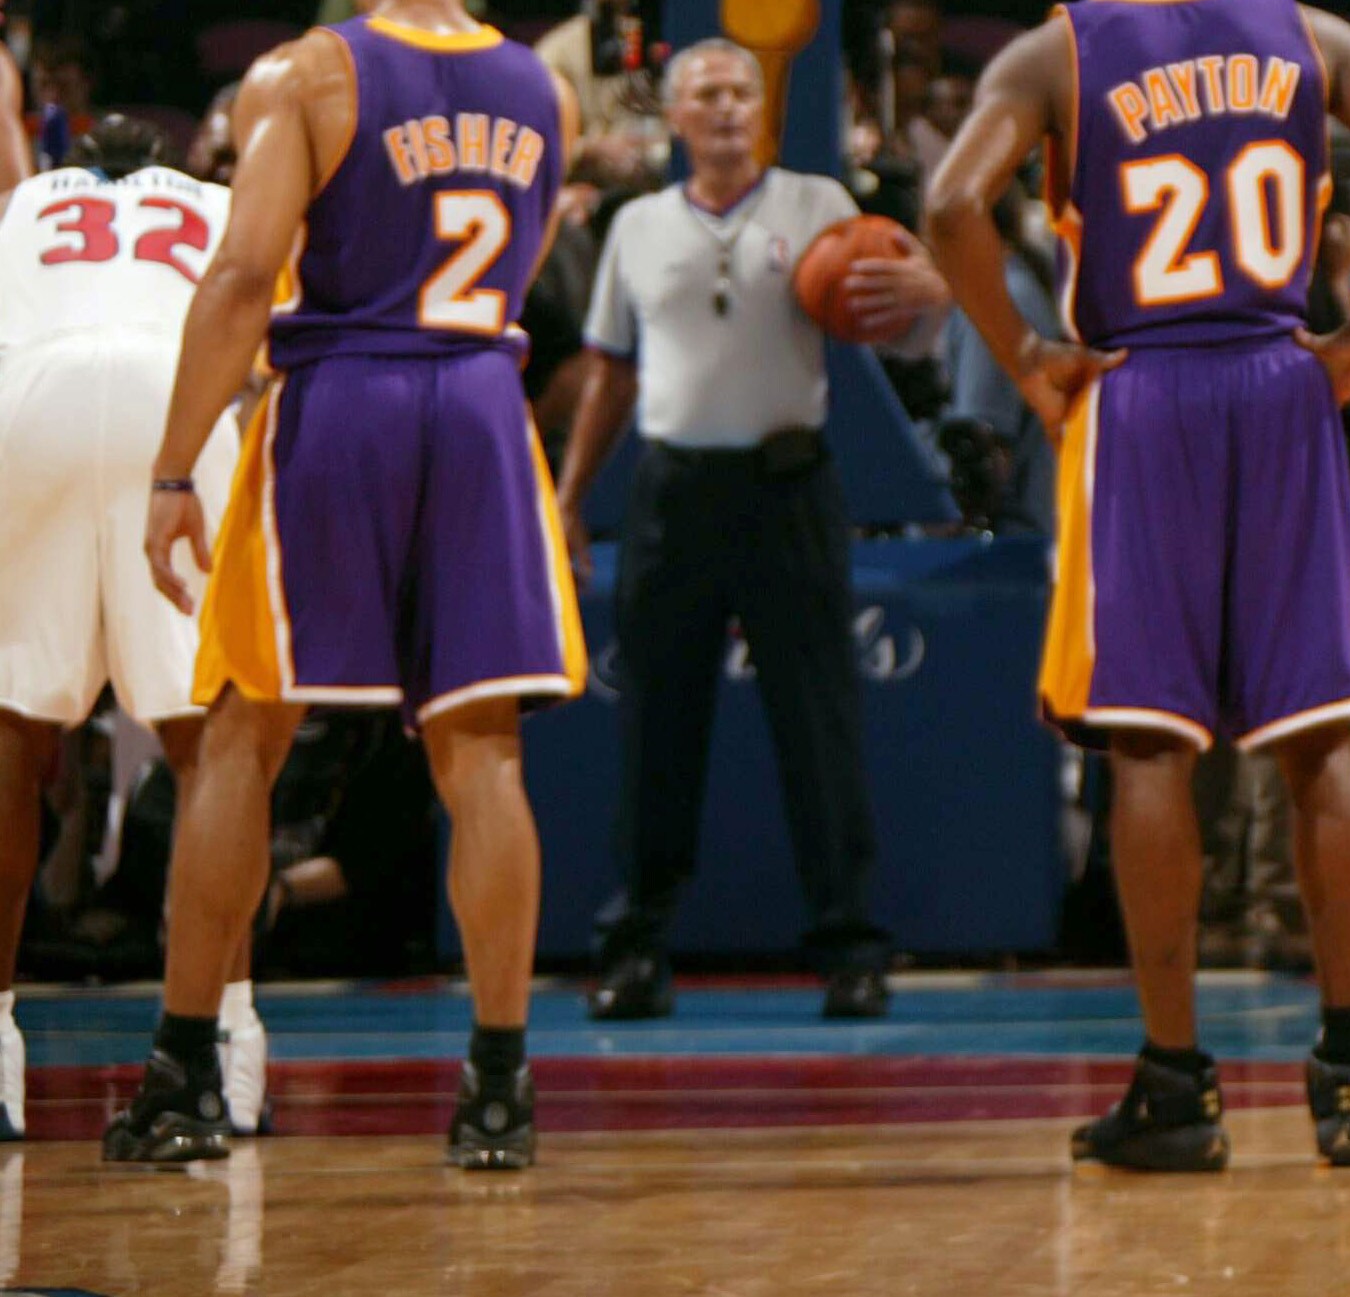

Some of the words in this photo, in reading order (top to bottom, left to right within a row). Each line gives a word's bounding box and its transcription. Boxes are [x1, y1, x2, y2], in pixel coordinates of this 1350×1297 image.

[1106, 53, 1300, 144] PAYTON
[382, 112, 544, 188] FISHER
[37, 195, 210, 285] 32
[416, 188, 513, 337] 2
[1118, 138, 1306, 308] 20
